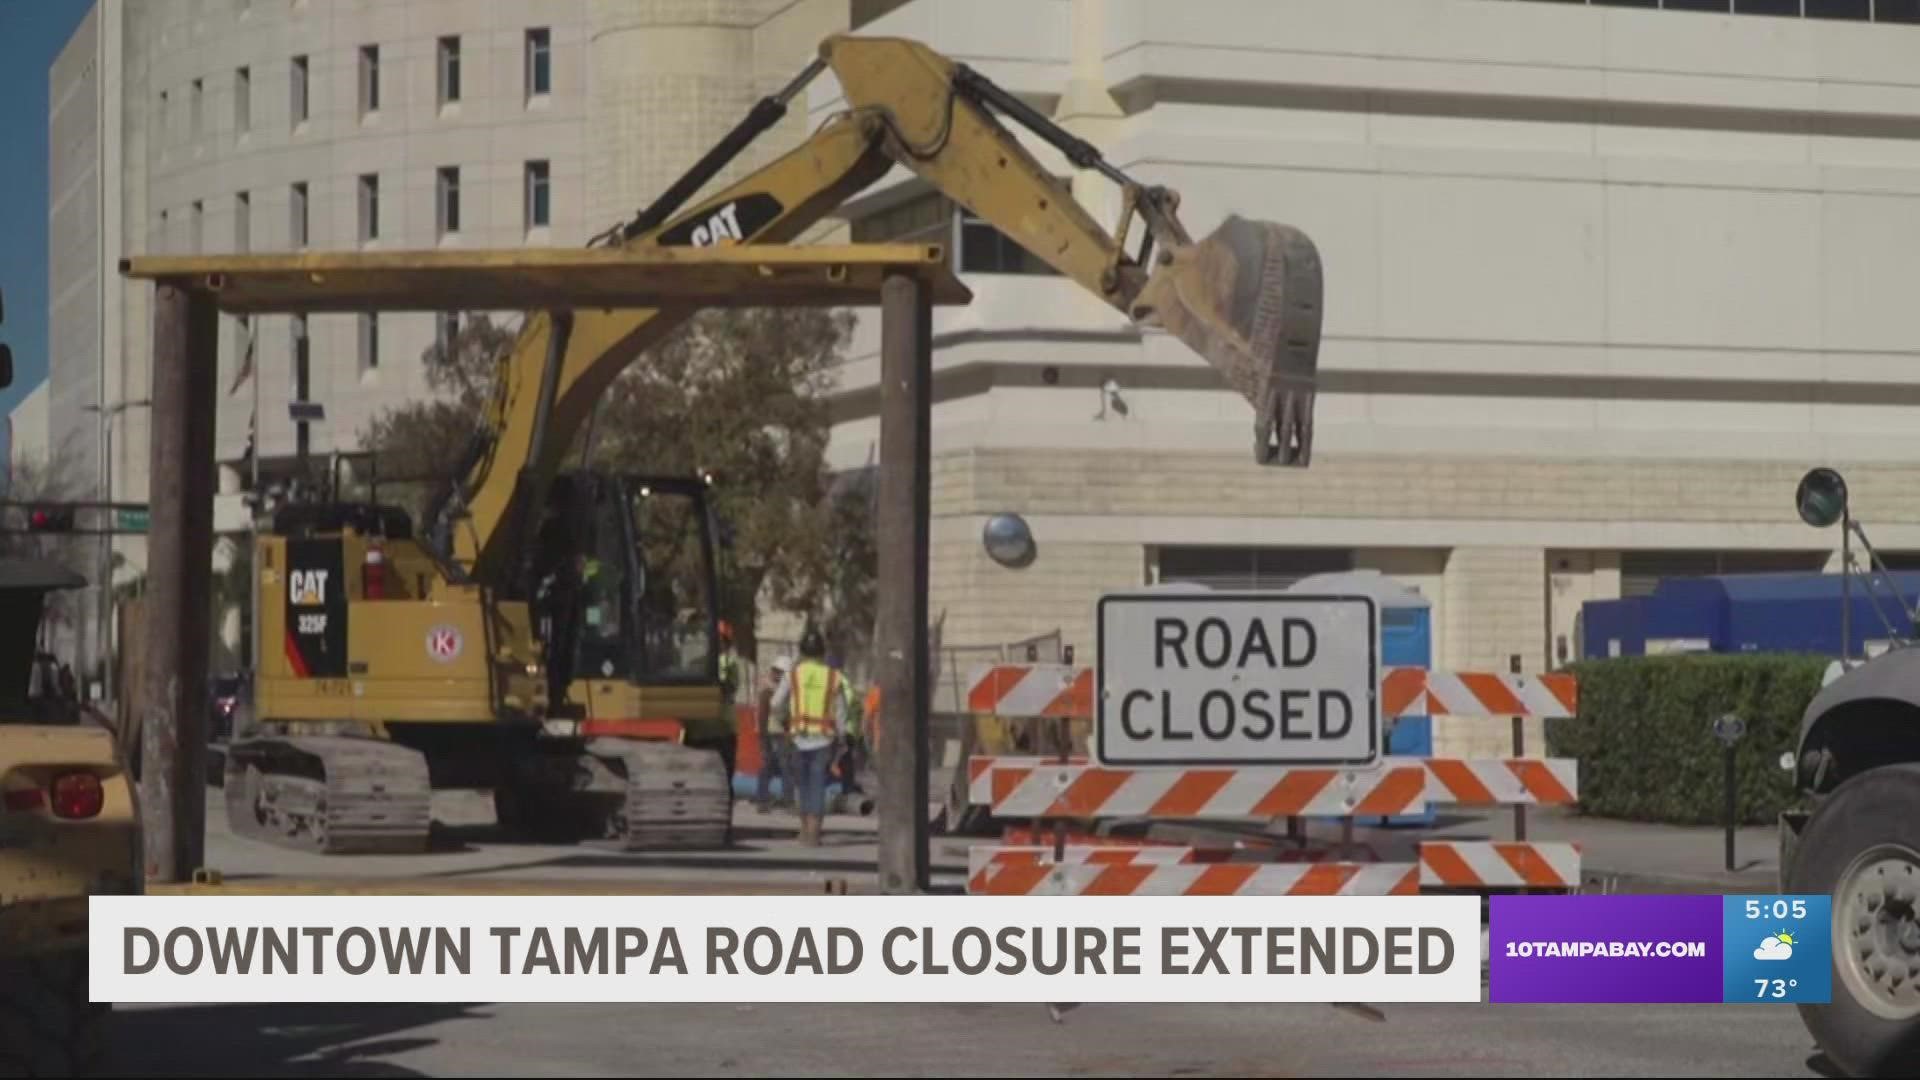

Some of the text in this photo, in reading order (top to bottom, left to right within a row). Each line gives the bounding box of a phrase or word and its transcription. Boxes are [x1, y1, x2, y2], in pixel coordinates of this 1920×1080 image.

[691, 202, 743, 247] CAT
[289, 569, 328, 605] CAT
[298, 613, 328, 633] 325F
[436, 630, 453, 656] K
[1154, 616, 1318, 670] ROAD
[1120, 688, 1353, 742] CLOSED
